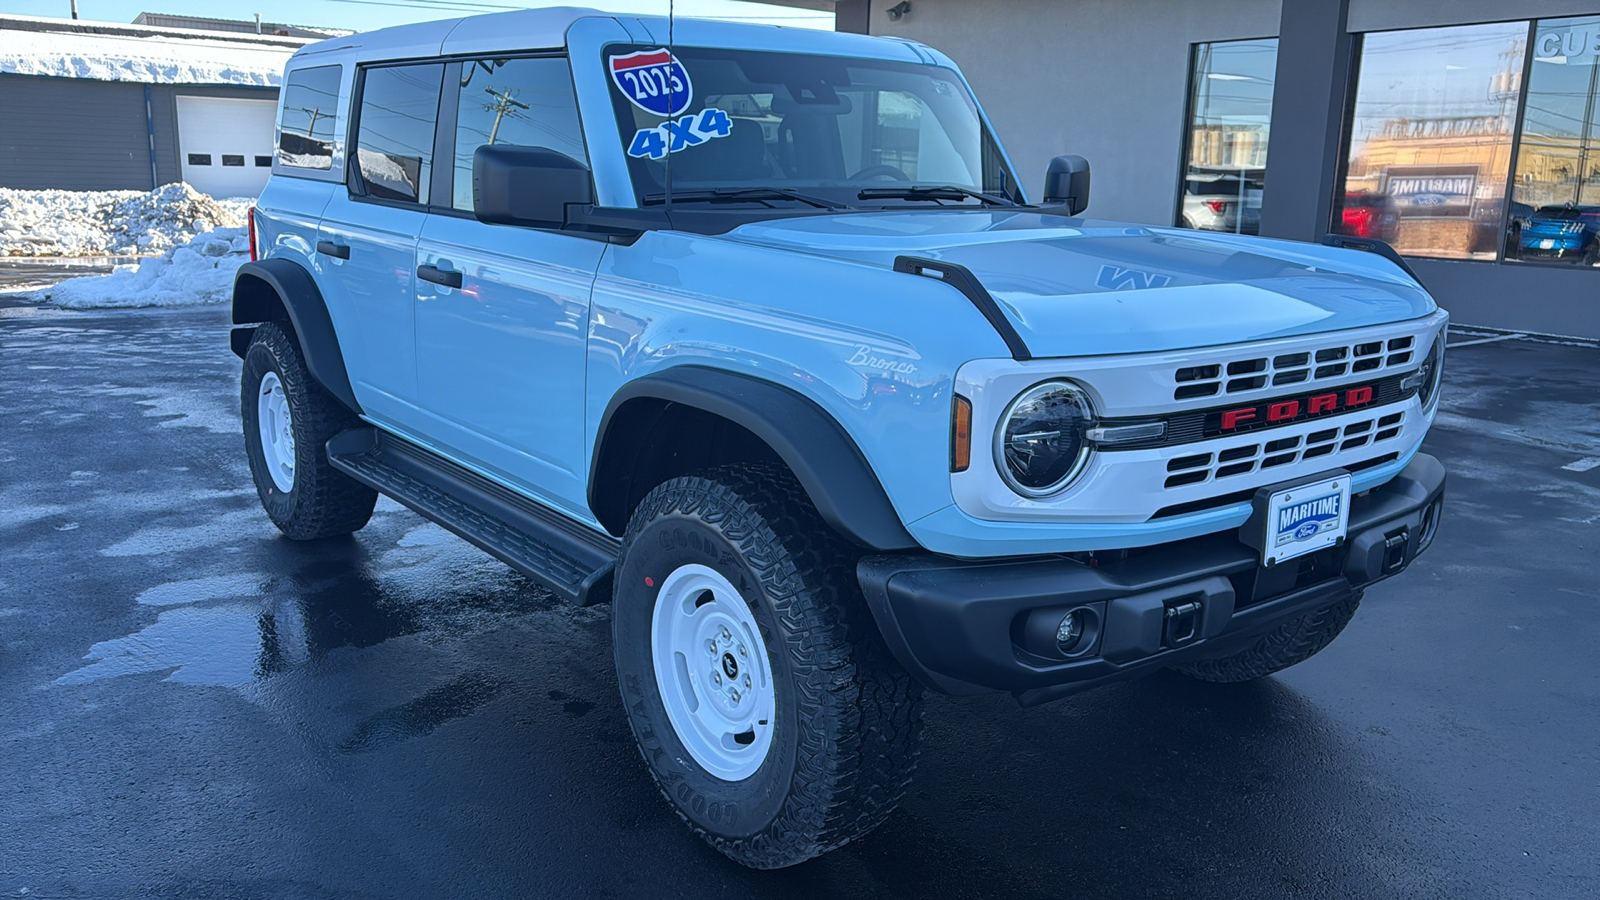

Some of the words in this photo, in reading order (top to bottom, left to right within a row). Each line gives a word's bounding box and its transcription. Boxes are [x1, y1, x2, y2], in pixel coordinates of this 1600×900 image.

[624, 66, 684, 100] 2025
[845, 343, 918, 375] Bronco
[1221, 386, 1373, 430] FORD
[1280, 495, 1340, 532] MARITIME
[1298, 524, 1316, 538] Ford
